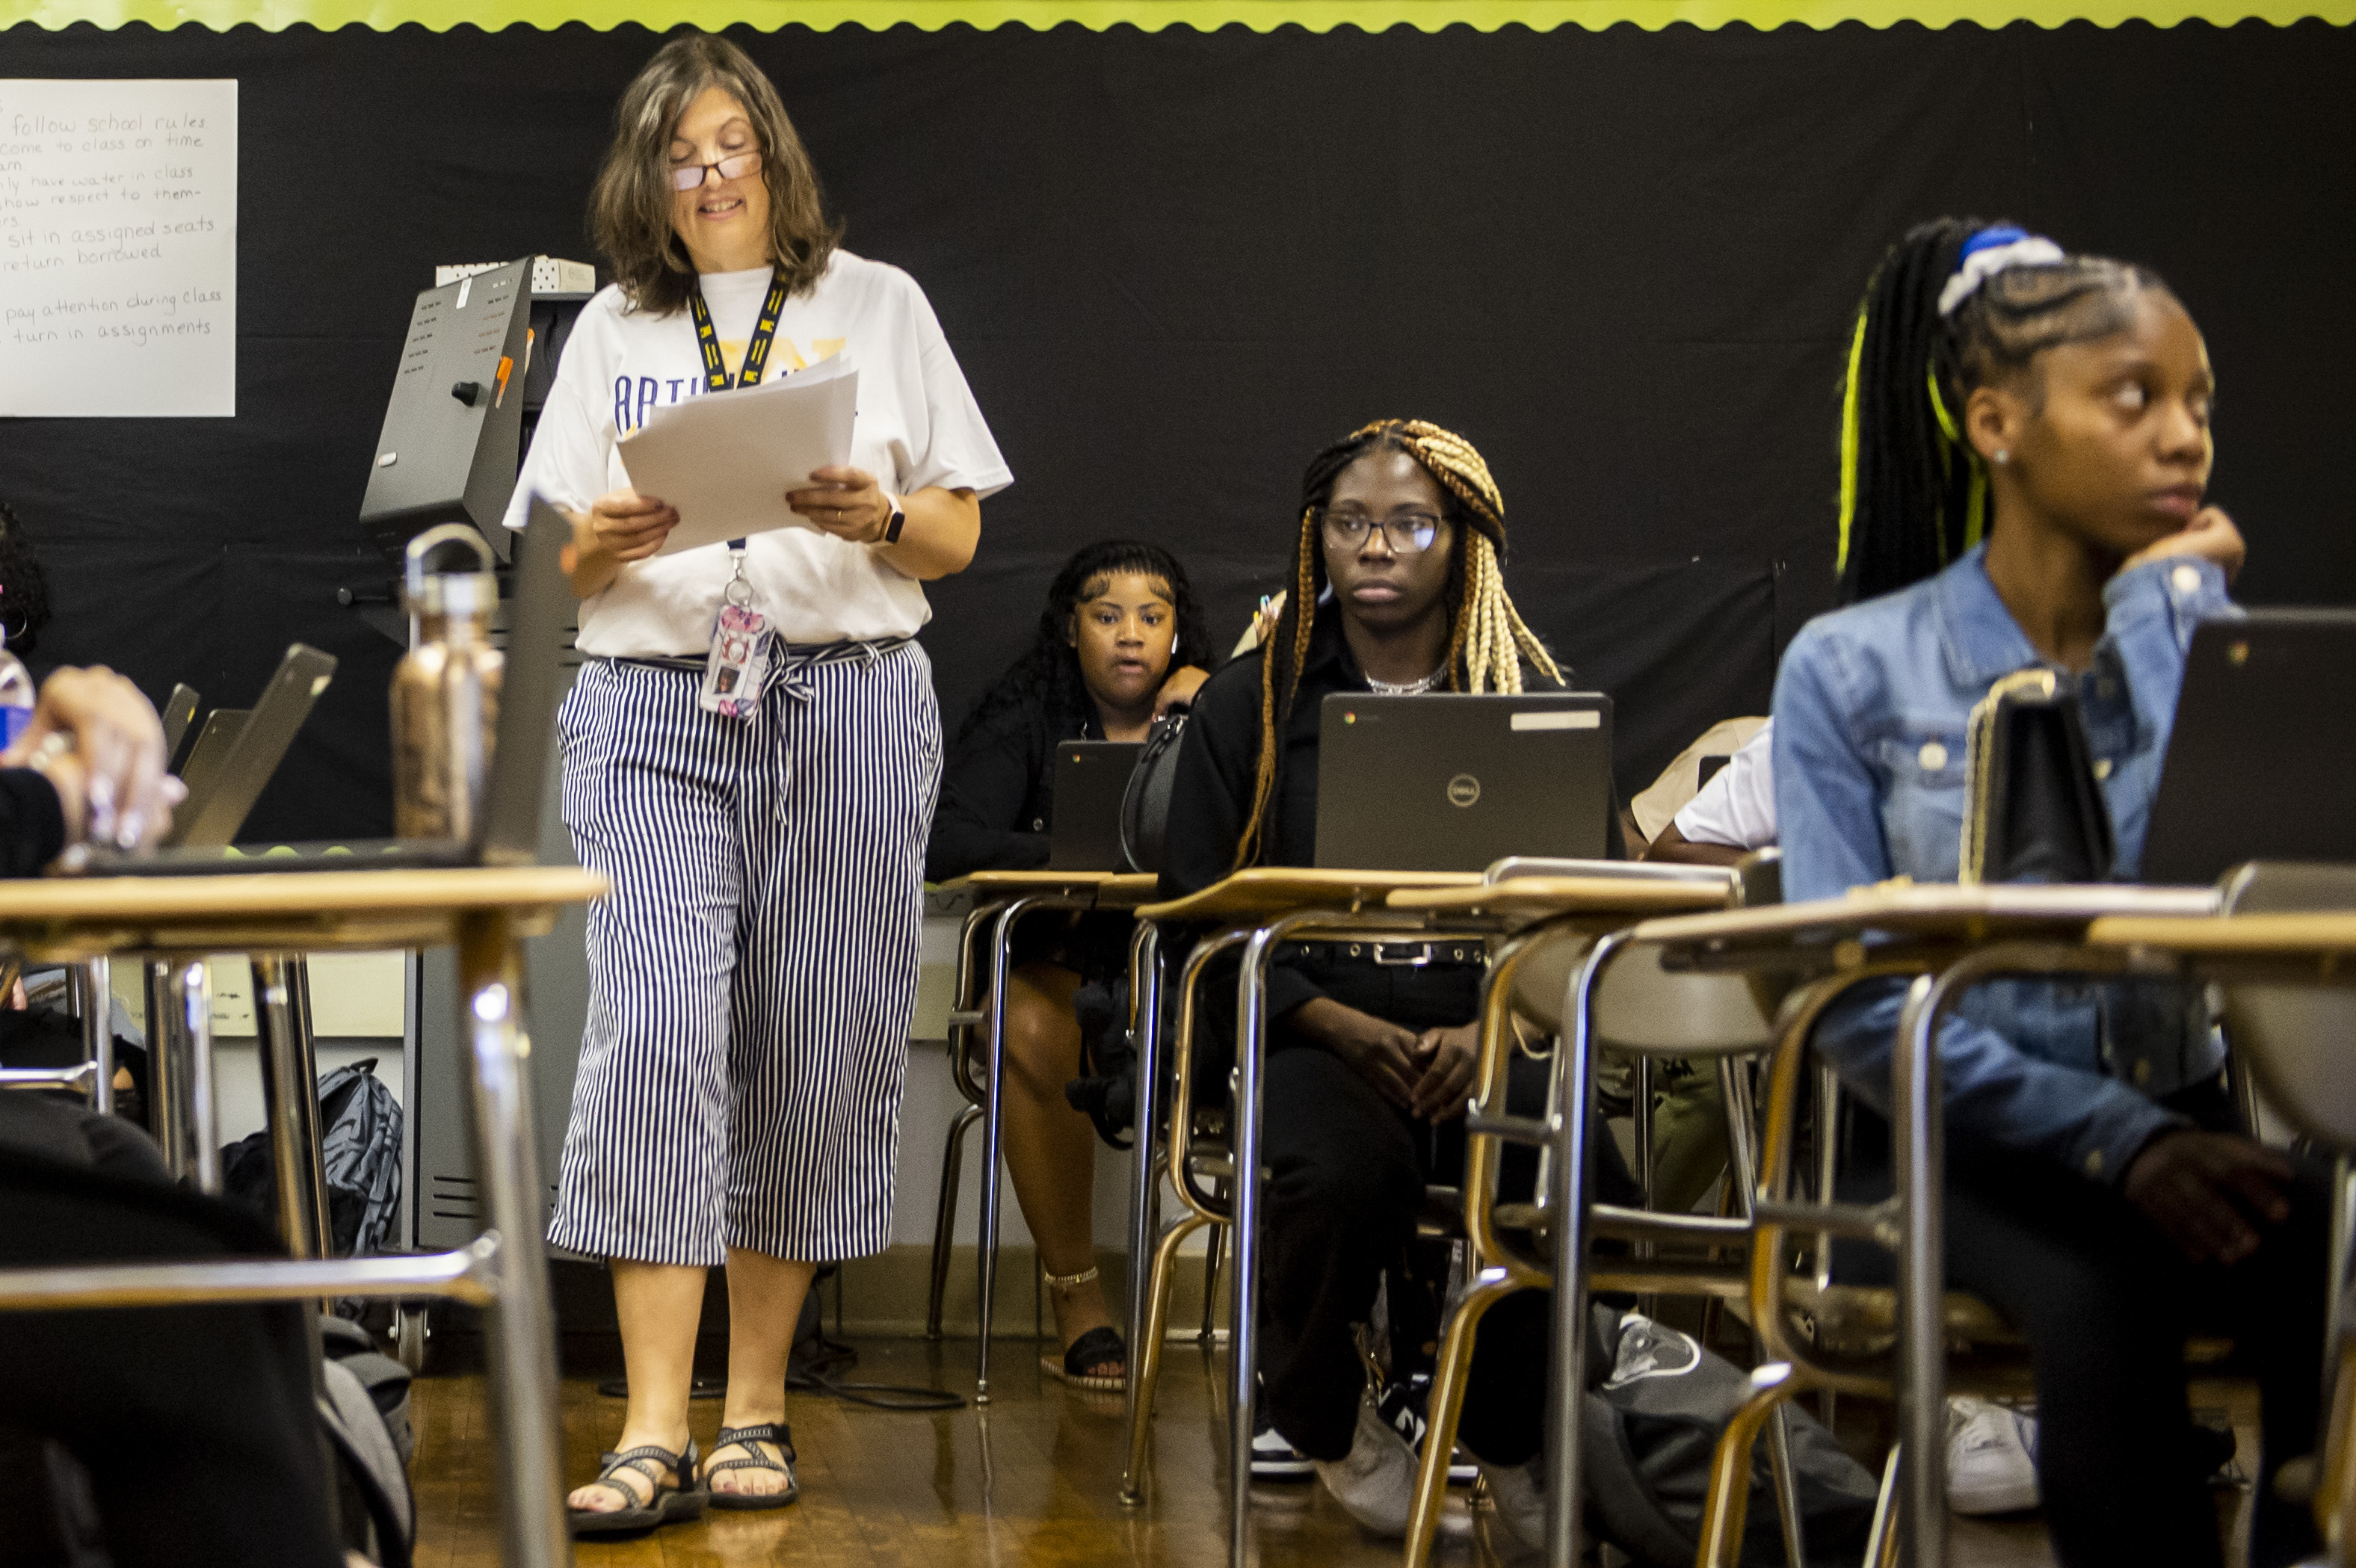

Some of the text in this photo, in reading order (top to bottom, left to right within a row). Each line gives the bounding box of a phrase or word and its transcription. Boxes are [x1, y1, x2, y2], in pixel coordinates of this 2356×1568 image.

[12, 111, 205, 136] follow school rules
[0, 132, 203, 154] come to class on time
[31, 176, 64, 186] have
[72, 171, 123, 186] water
[132, 170, 145, 181] in
[154, 163, 193, 179] class
[51, 188, 108, 205] respect
[121, 187, 140, 200] to
[154, 187, 200, 200] them-
[8, 214, 214, 254] sit in assigned seats
[3, 242, 161, 271] return borrowed
[6, 286, 221, 326] pay attention during class
[13, 318, 211, 347] turn in assignments
